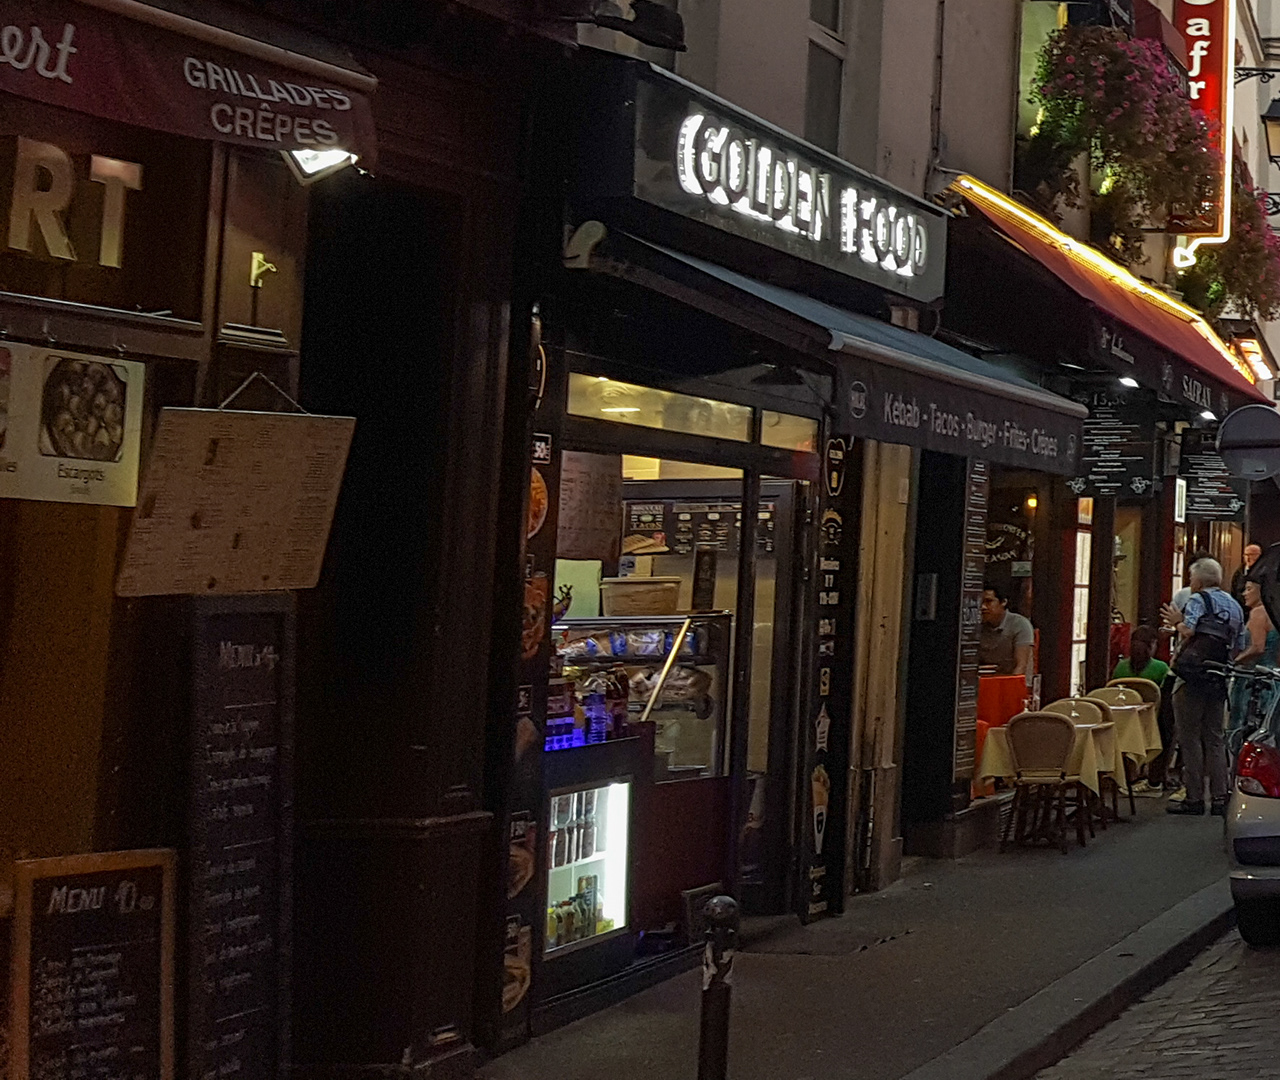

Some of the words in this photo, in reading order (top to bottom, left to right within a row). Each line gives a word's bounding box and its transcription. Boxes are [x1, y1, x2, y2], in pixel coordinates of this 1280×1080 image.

[183, 57, 351, 111] GRILLADES
[210, 103, 338, 146] CRÊPES
[677, 112, 833, 242] GOLDEN
[840, 187, 928, 277] FOOD
[884, 392, 920, 429] Kebab
[930, 402, 959, 437] Tacos
[966, 412, 998, 448] Burger
